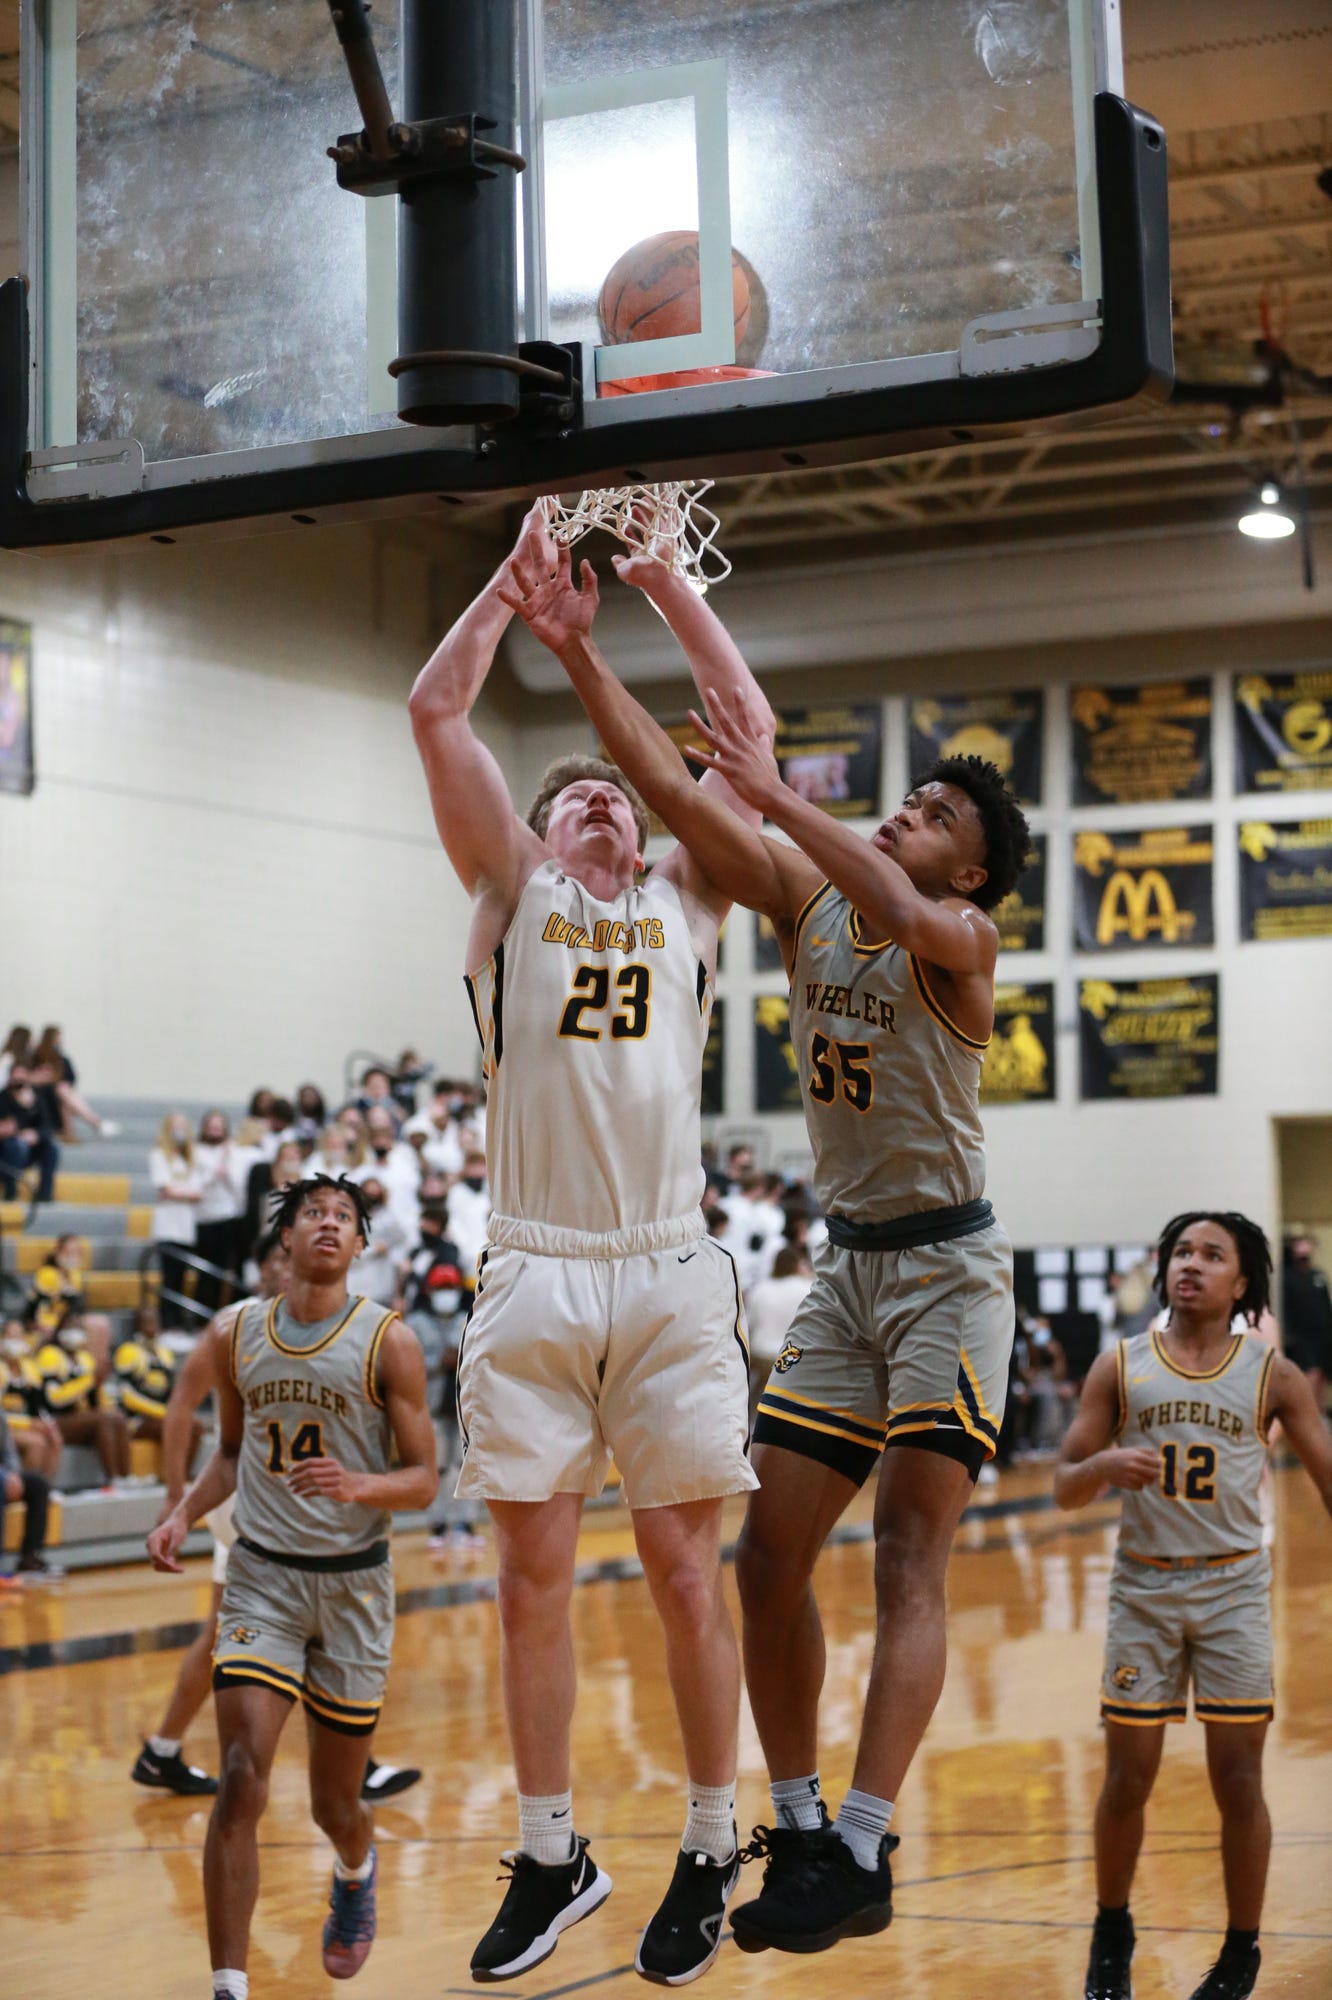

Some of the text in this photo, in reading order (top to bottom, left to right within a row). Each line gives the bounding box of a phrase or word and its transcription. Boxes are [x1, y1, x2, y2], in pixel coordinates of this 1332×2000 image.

[542, 912, 665, 955] WILDCATS
[557, 963, 652, 1042] 23
[809, 1029, 874, 1113] 55
[247, 1379, 347, 1417] WHEELER
[1138, 1400, 1243, 1440] WHEELER
[266, 1420, 327, 1475] 14
[1160, 1441, 1217, 1502] 12
